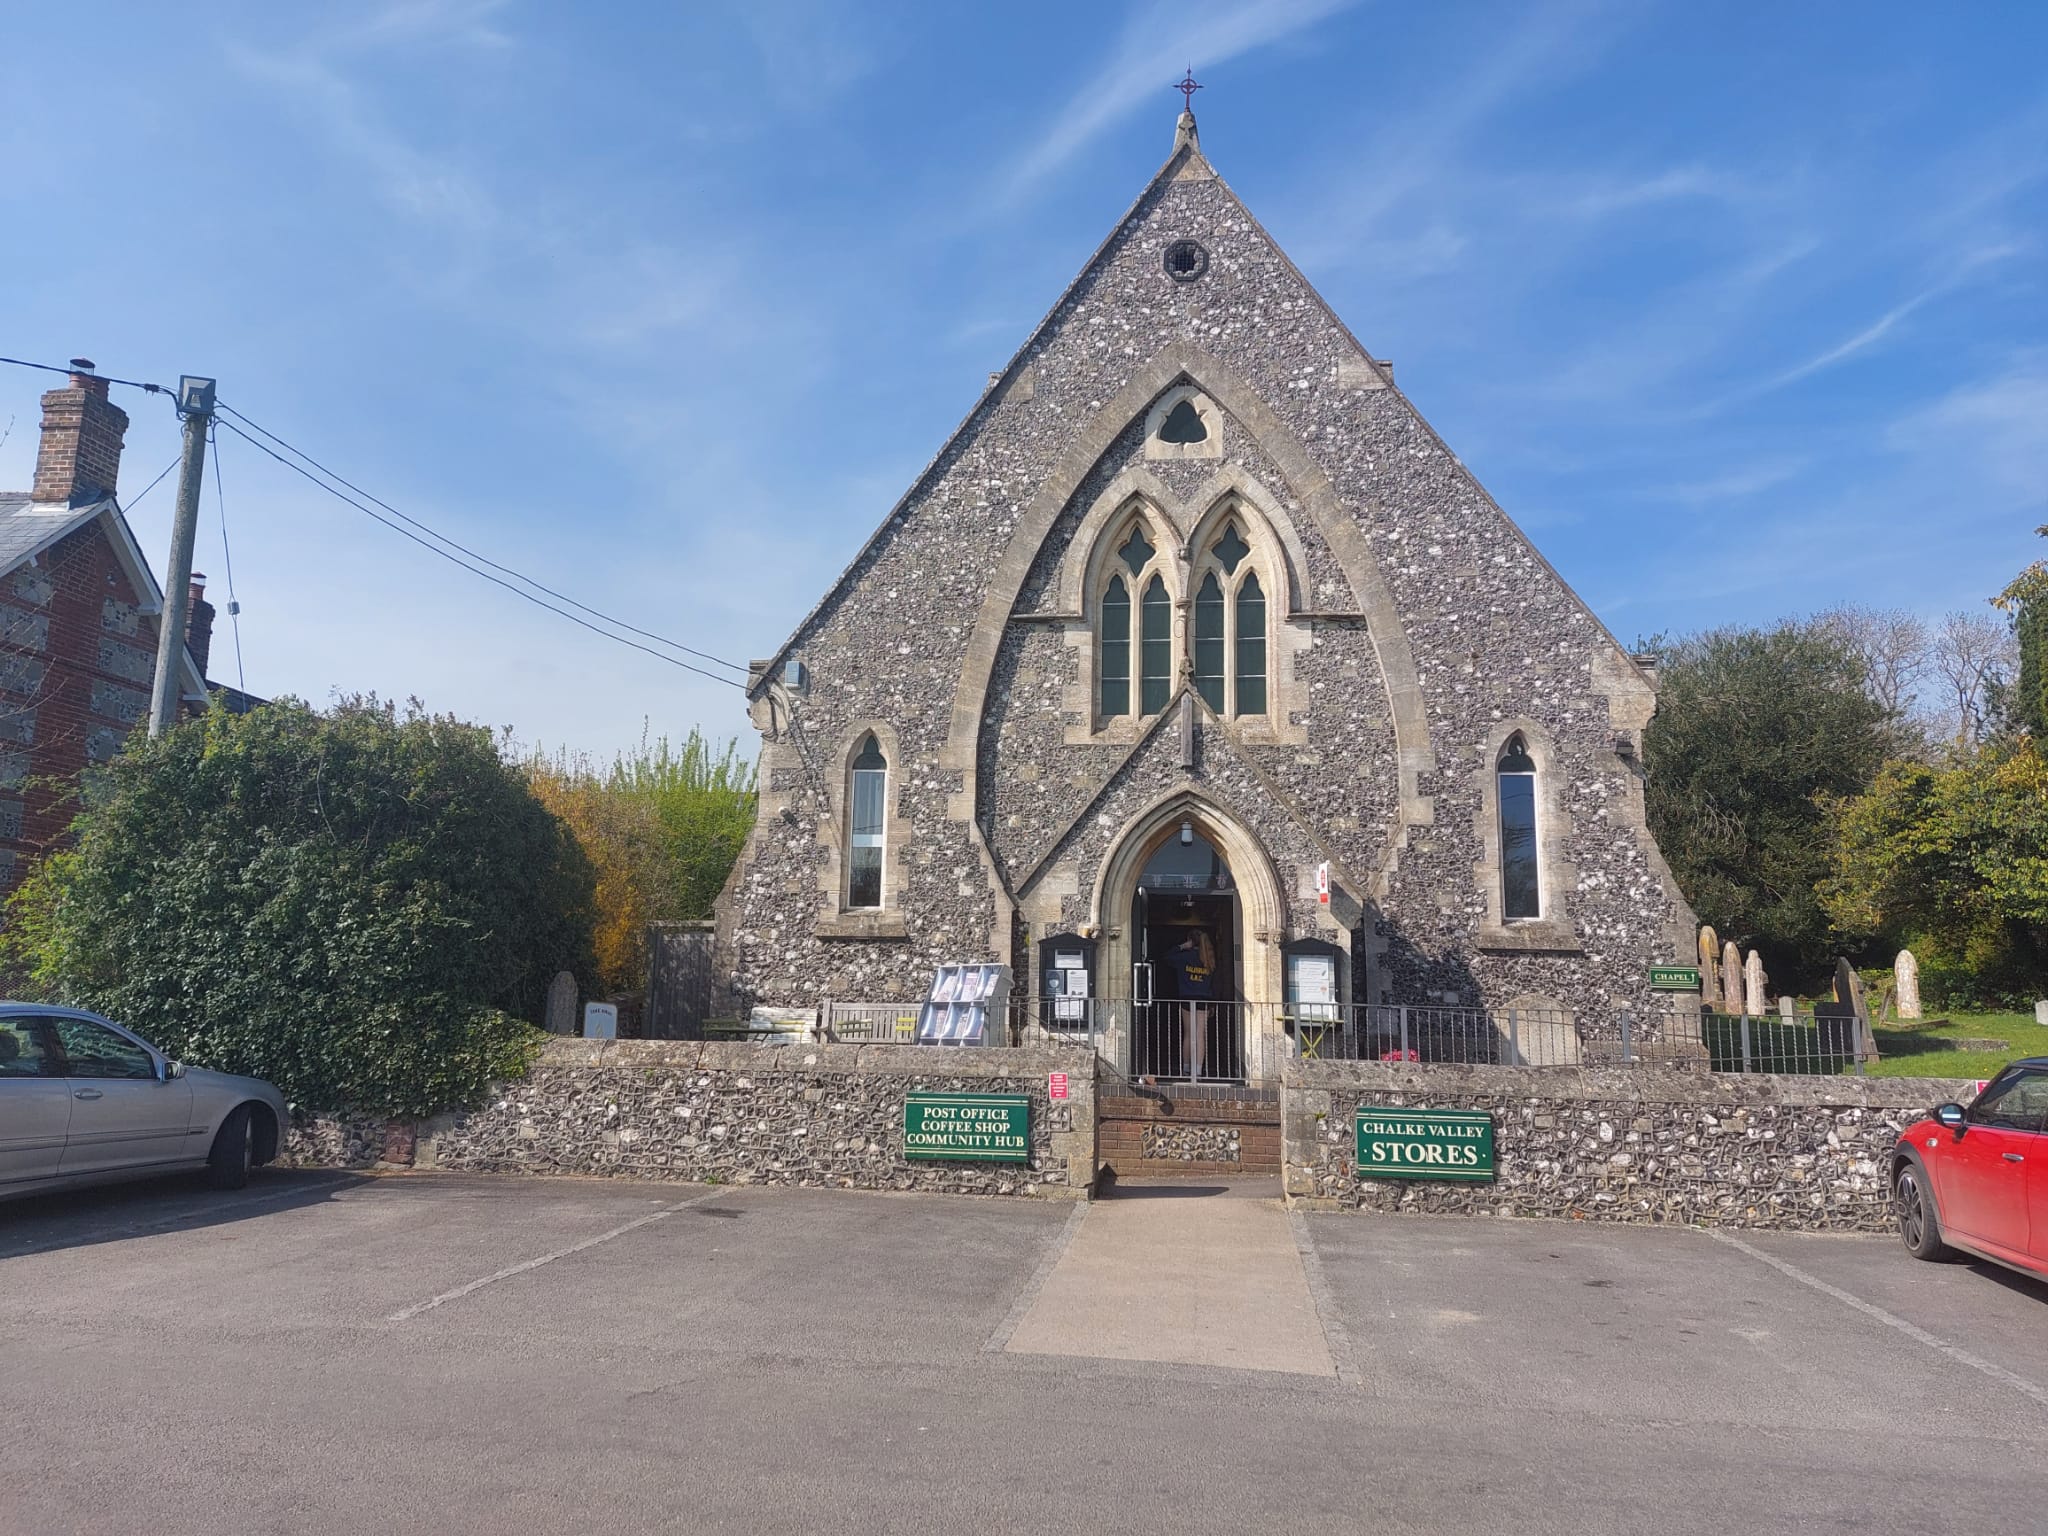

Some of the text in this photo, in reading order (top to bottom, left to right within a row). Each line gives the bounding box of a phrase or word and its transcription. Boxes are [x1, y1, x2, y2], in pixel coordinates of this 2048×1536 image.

[1655, 973, 1690, 981] CHAPEL
[923, 1107, 1009, 1120] POST OFFICE
[921, 1120, 1011, 1134] COFFEE SHOP
[1363, 1122, 1485, 1138] CHALKE VALLEY
[907, 1133, 1025, 1147] COMMUNITY HUB
[1372, 1141, 1478, 1165] STORES
